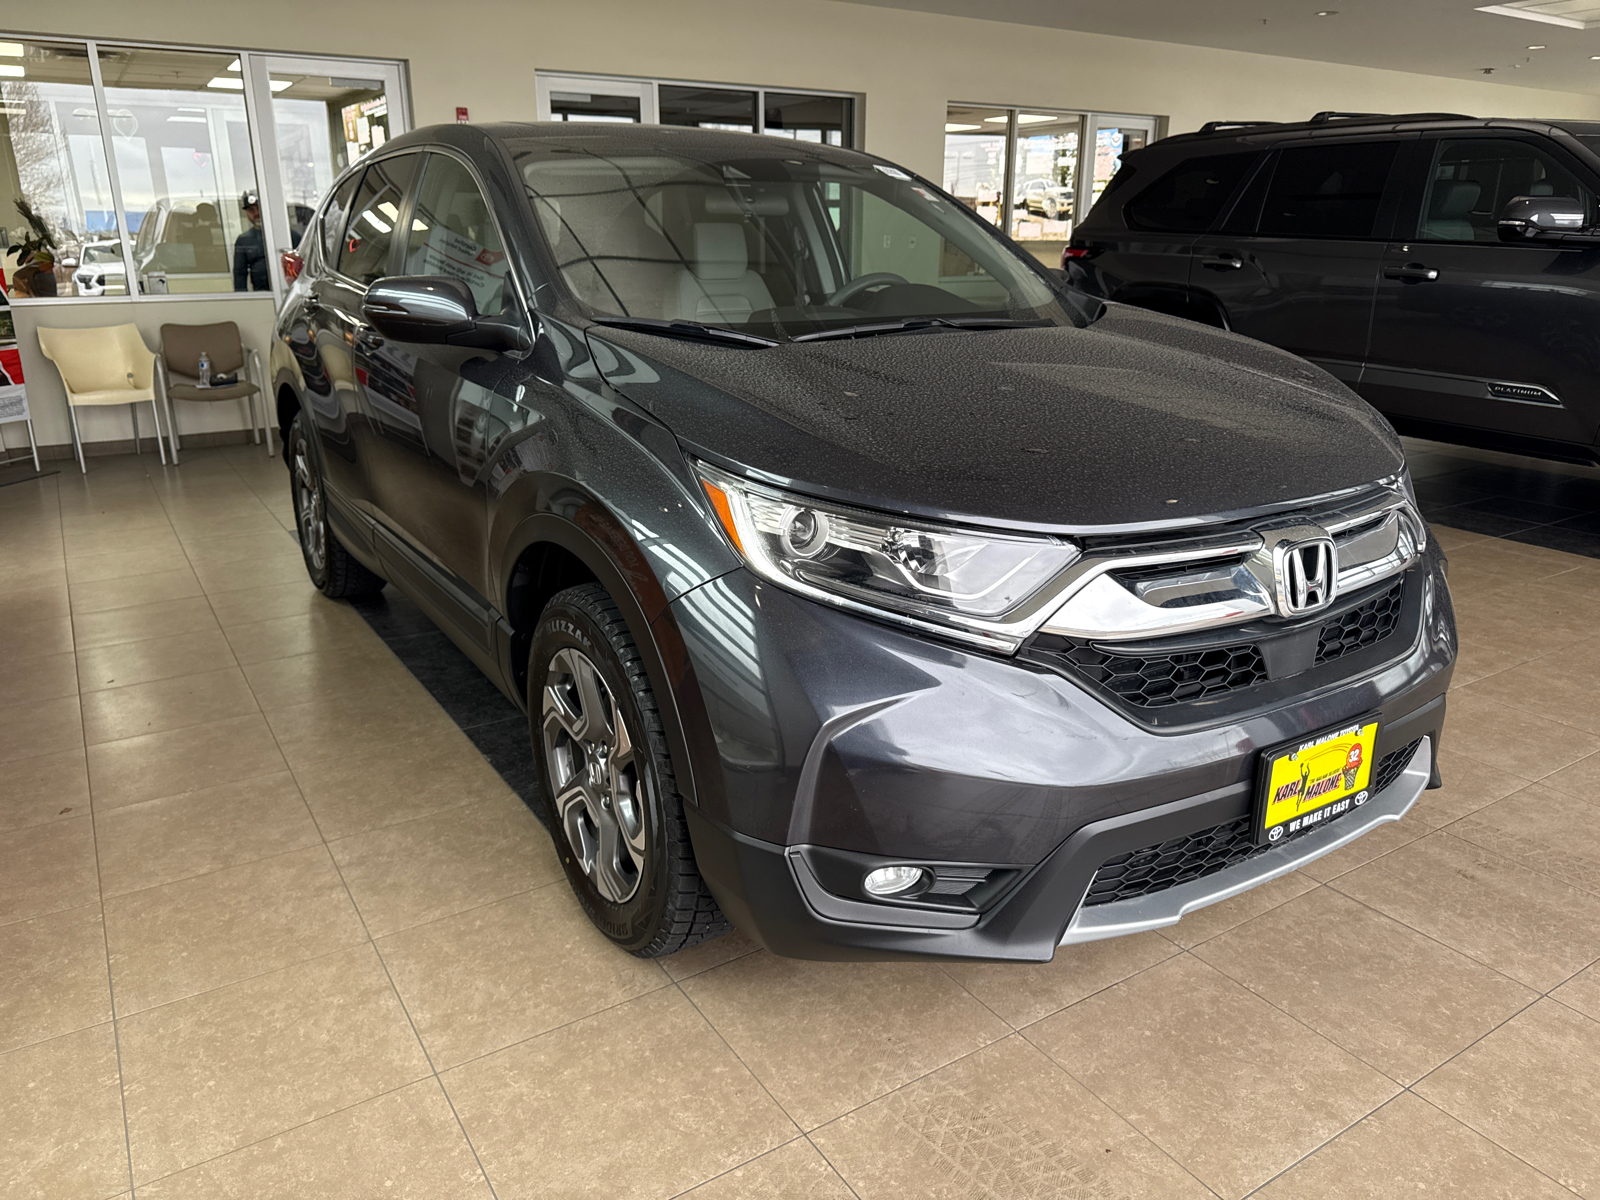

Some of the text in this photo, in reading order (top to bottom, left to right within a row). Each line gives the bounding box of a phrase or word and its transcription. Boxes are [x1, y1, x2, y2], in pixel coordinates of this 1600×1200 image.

[1494, 386, 1542, 396] PLATINUM
[545, 619, 592, 650] BLIZZAK
[1349, 749, 1359, 762] 32
[1271, 778, 1302, 805] KARL
[1302, 772, 1344, 803] MALONE
[1289, 799, 1350, 832] WE MAKE IT EASY
